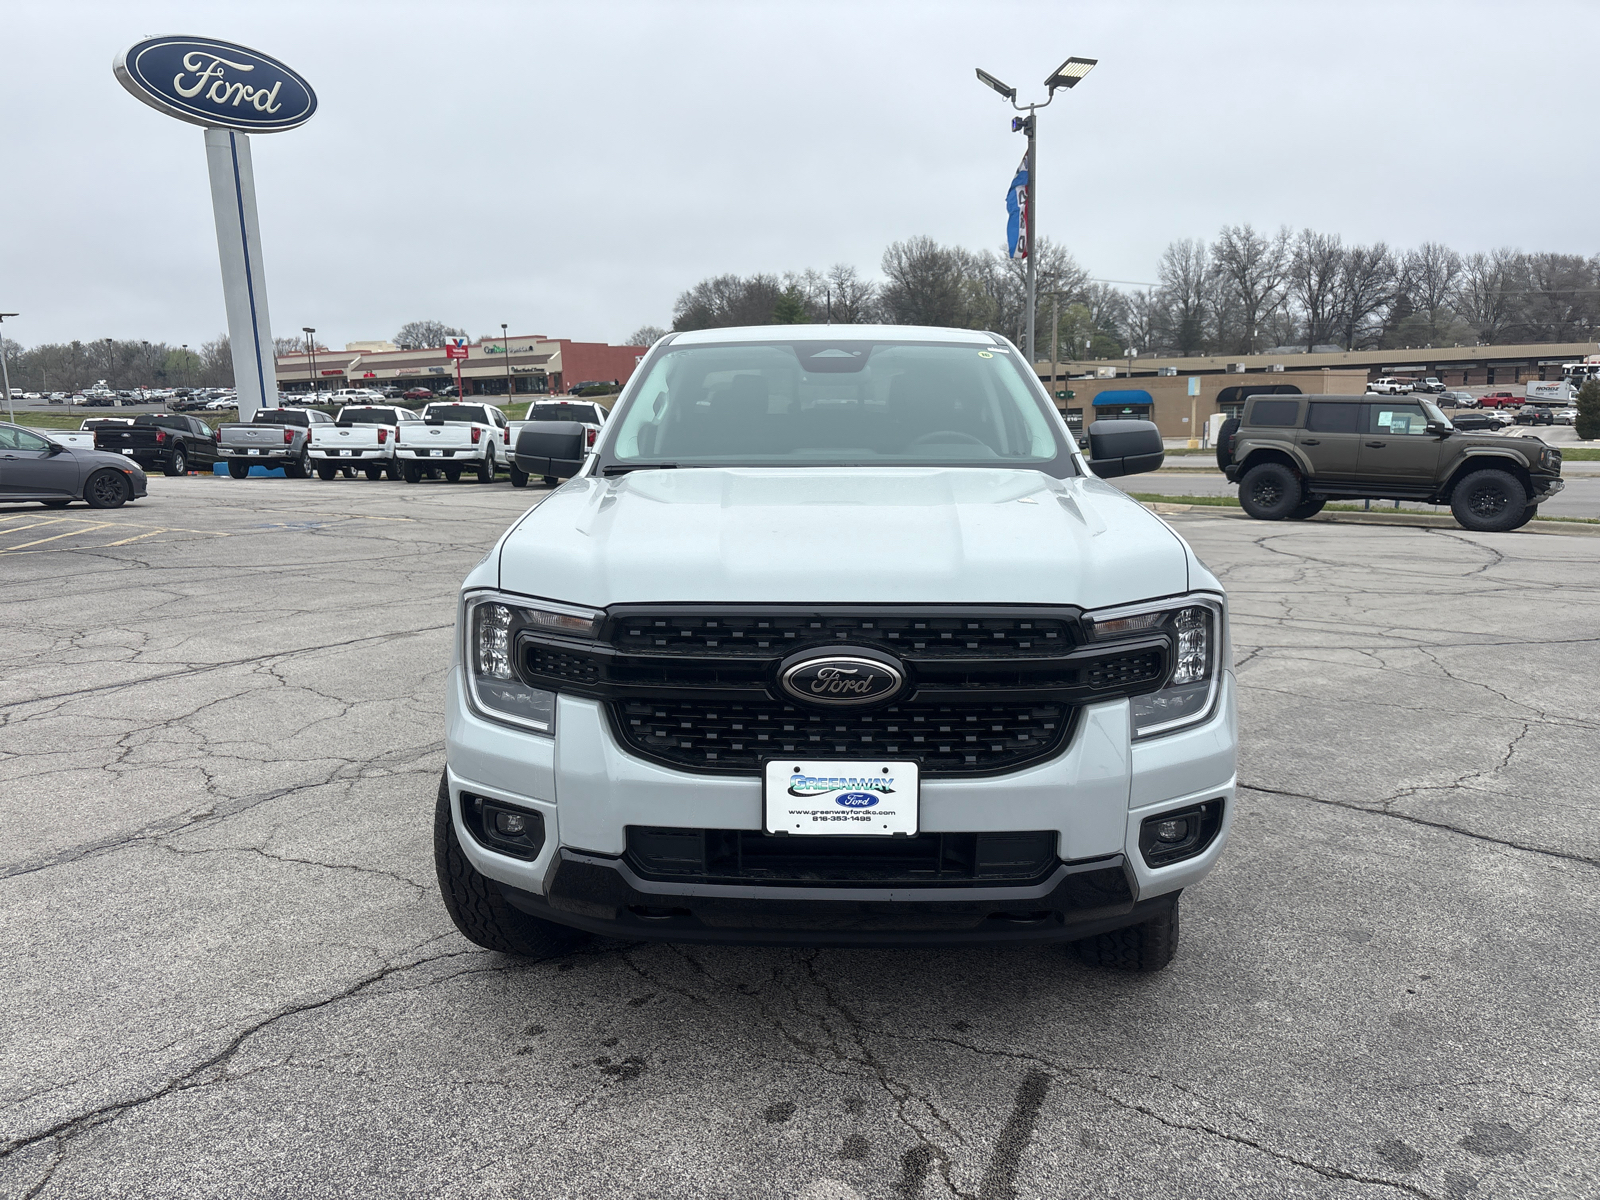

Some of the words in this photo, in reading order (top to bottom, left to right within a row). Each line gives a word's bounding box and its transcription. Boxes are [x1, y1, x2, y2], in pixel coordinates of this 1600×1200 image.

[173, 51, 282, 114] Ford
[810, 667, 874, 693] Ford
[790, 774, 894, 791] GREENWAY
[845, 794, 870, 806] Ford
